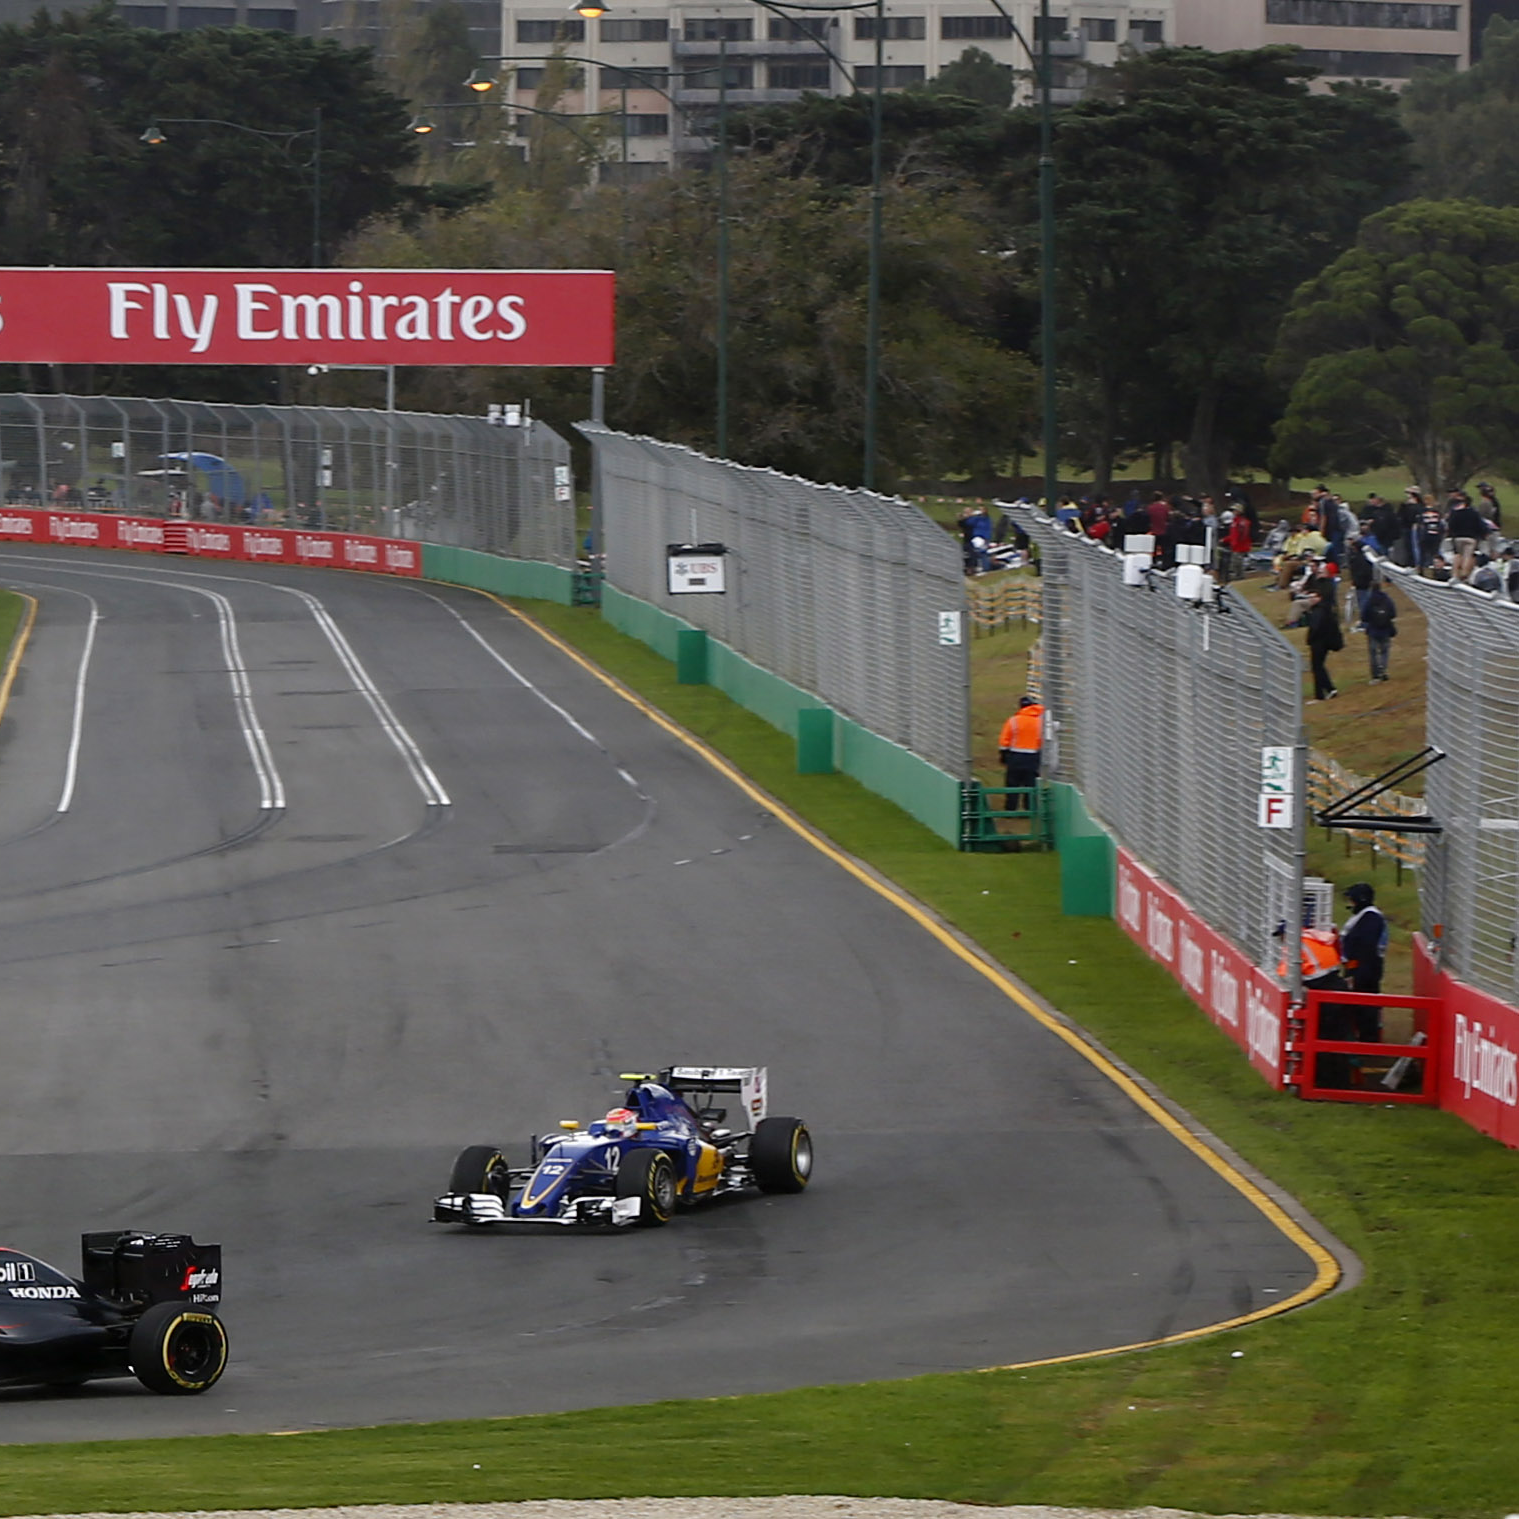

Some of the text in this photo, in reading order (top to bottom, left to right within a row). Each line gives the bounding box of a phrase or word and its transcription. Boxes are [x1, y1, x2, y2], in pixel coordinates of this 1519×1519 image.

[107, 280, 527, 352] Fly Emirates
[1267, 798, 1284, 824] F
[542, 1165, 564, 1175] 12
[605, 1146, 621, 1175] 12
[8, 1286, 81, 1299] HONDA
